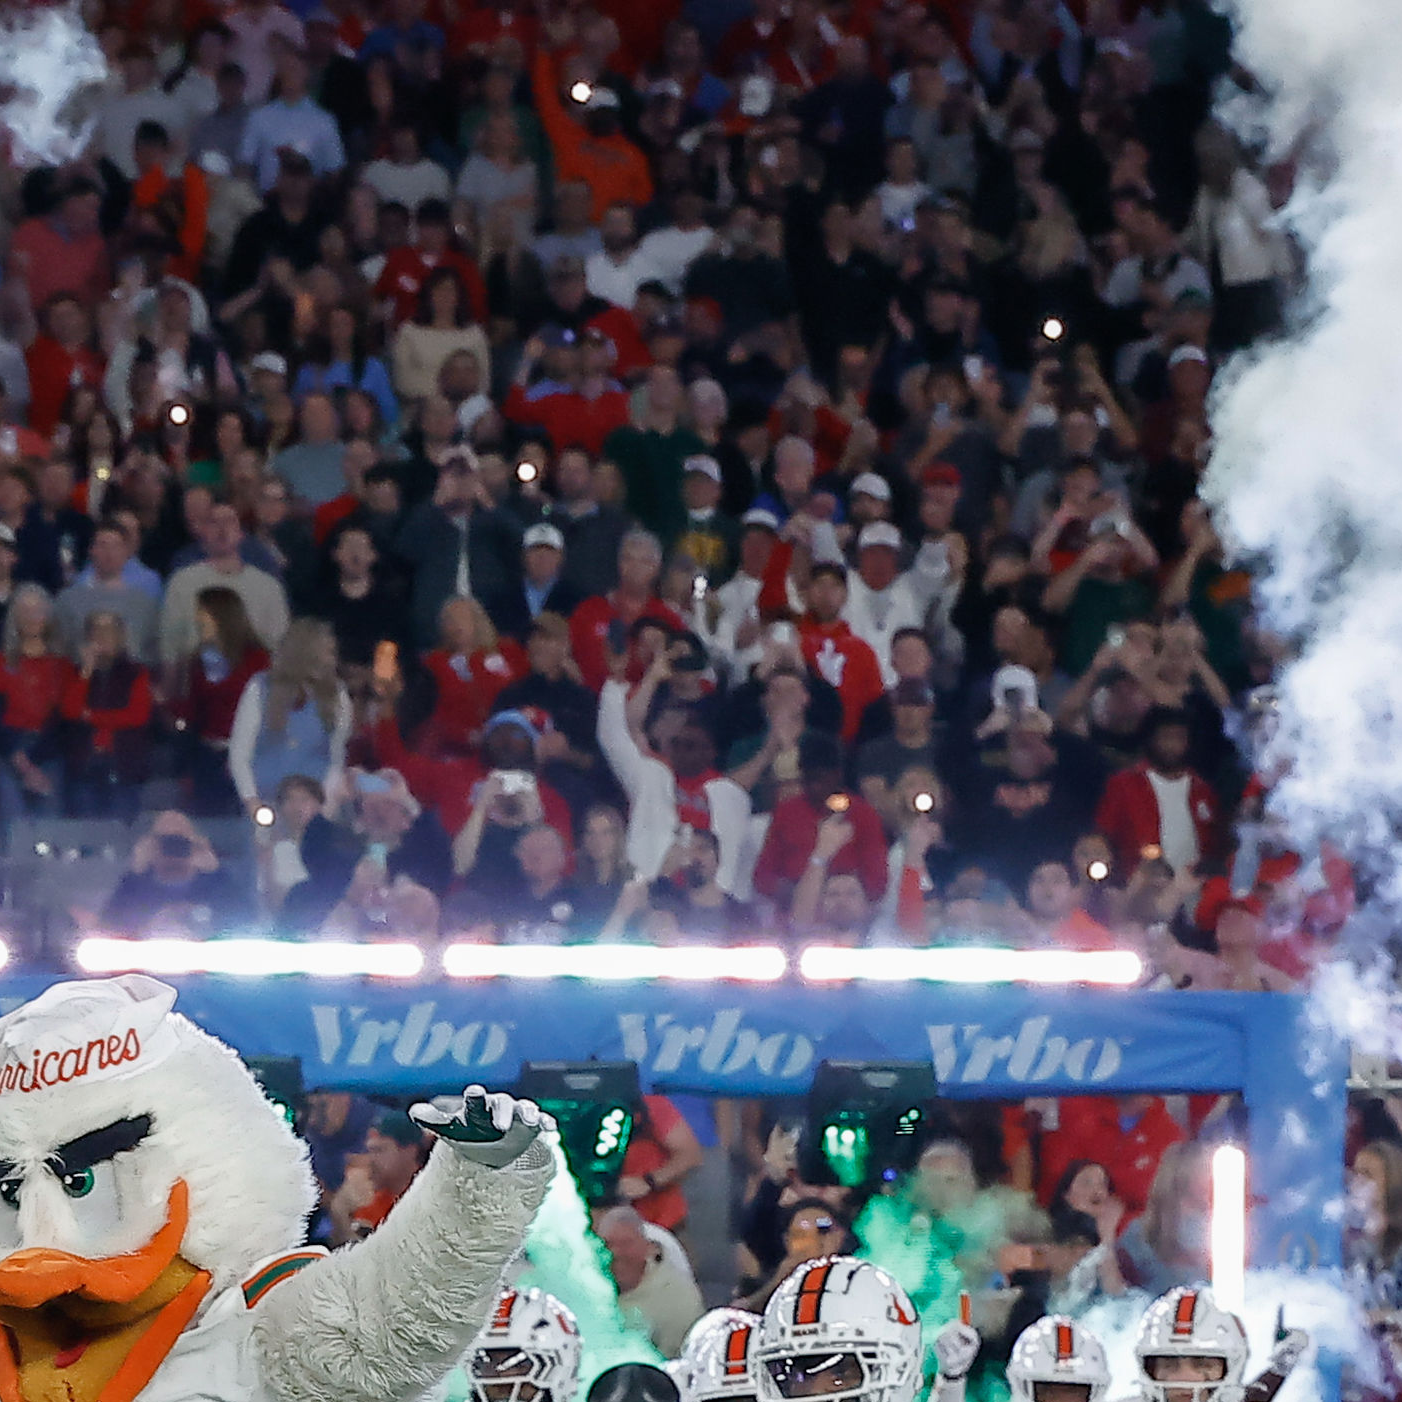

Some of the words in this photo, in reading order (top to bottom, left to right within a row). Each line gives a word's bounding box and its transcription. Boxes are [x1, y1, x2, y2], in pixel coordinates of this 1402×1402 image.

[312, 1001, 508, 1067] Vrbo
[618, 1008, 814, 1078] Vrbo
[926, 1015, 1122, 1083] Vrbo
